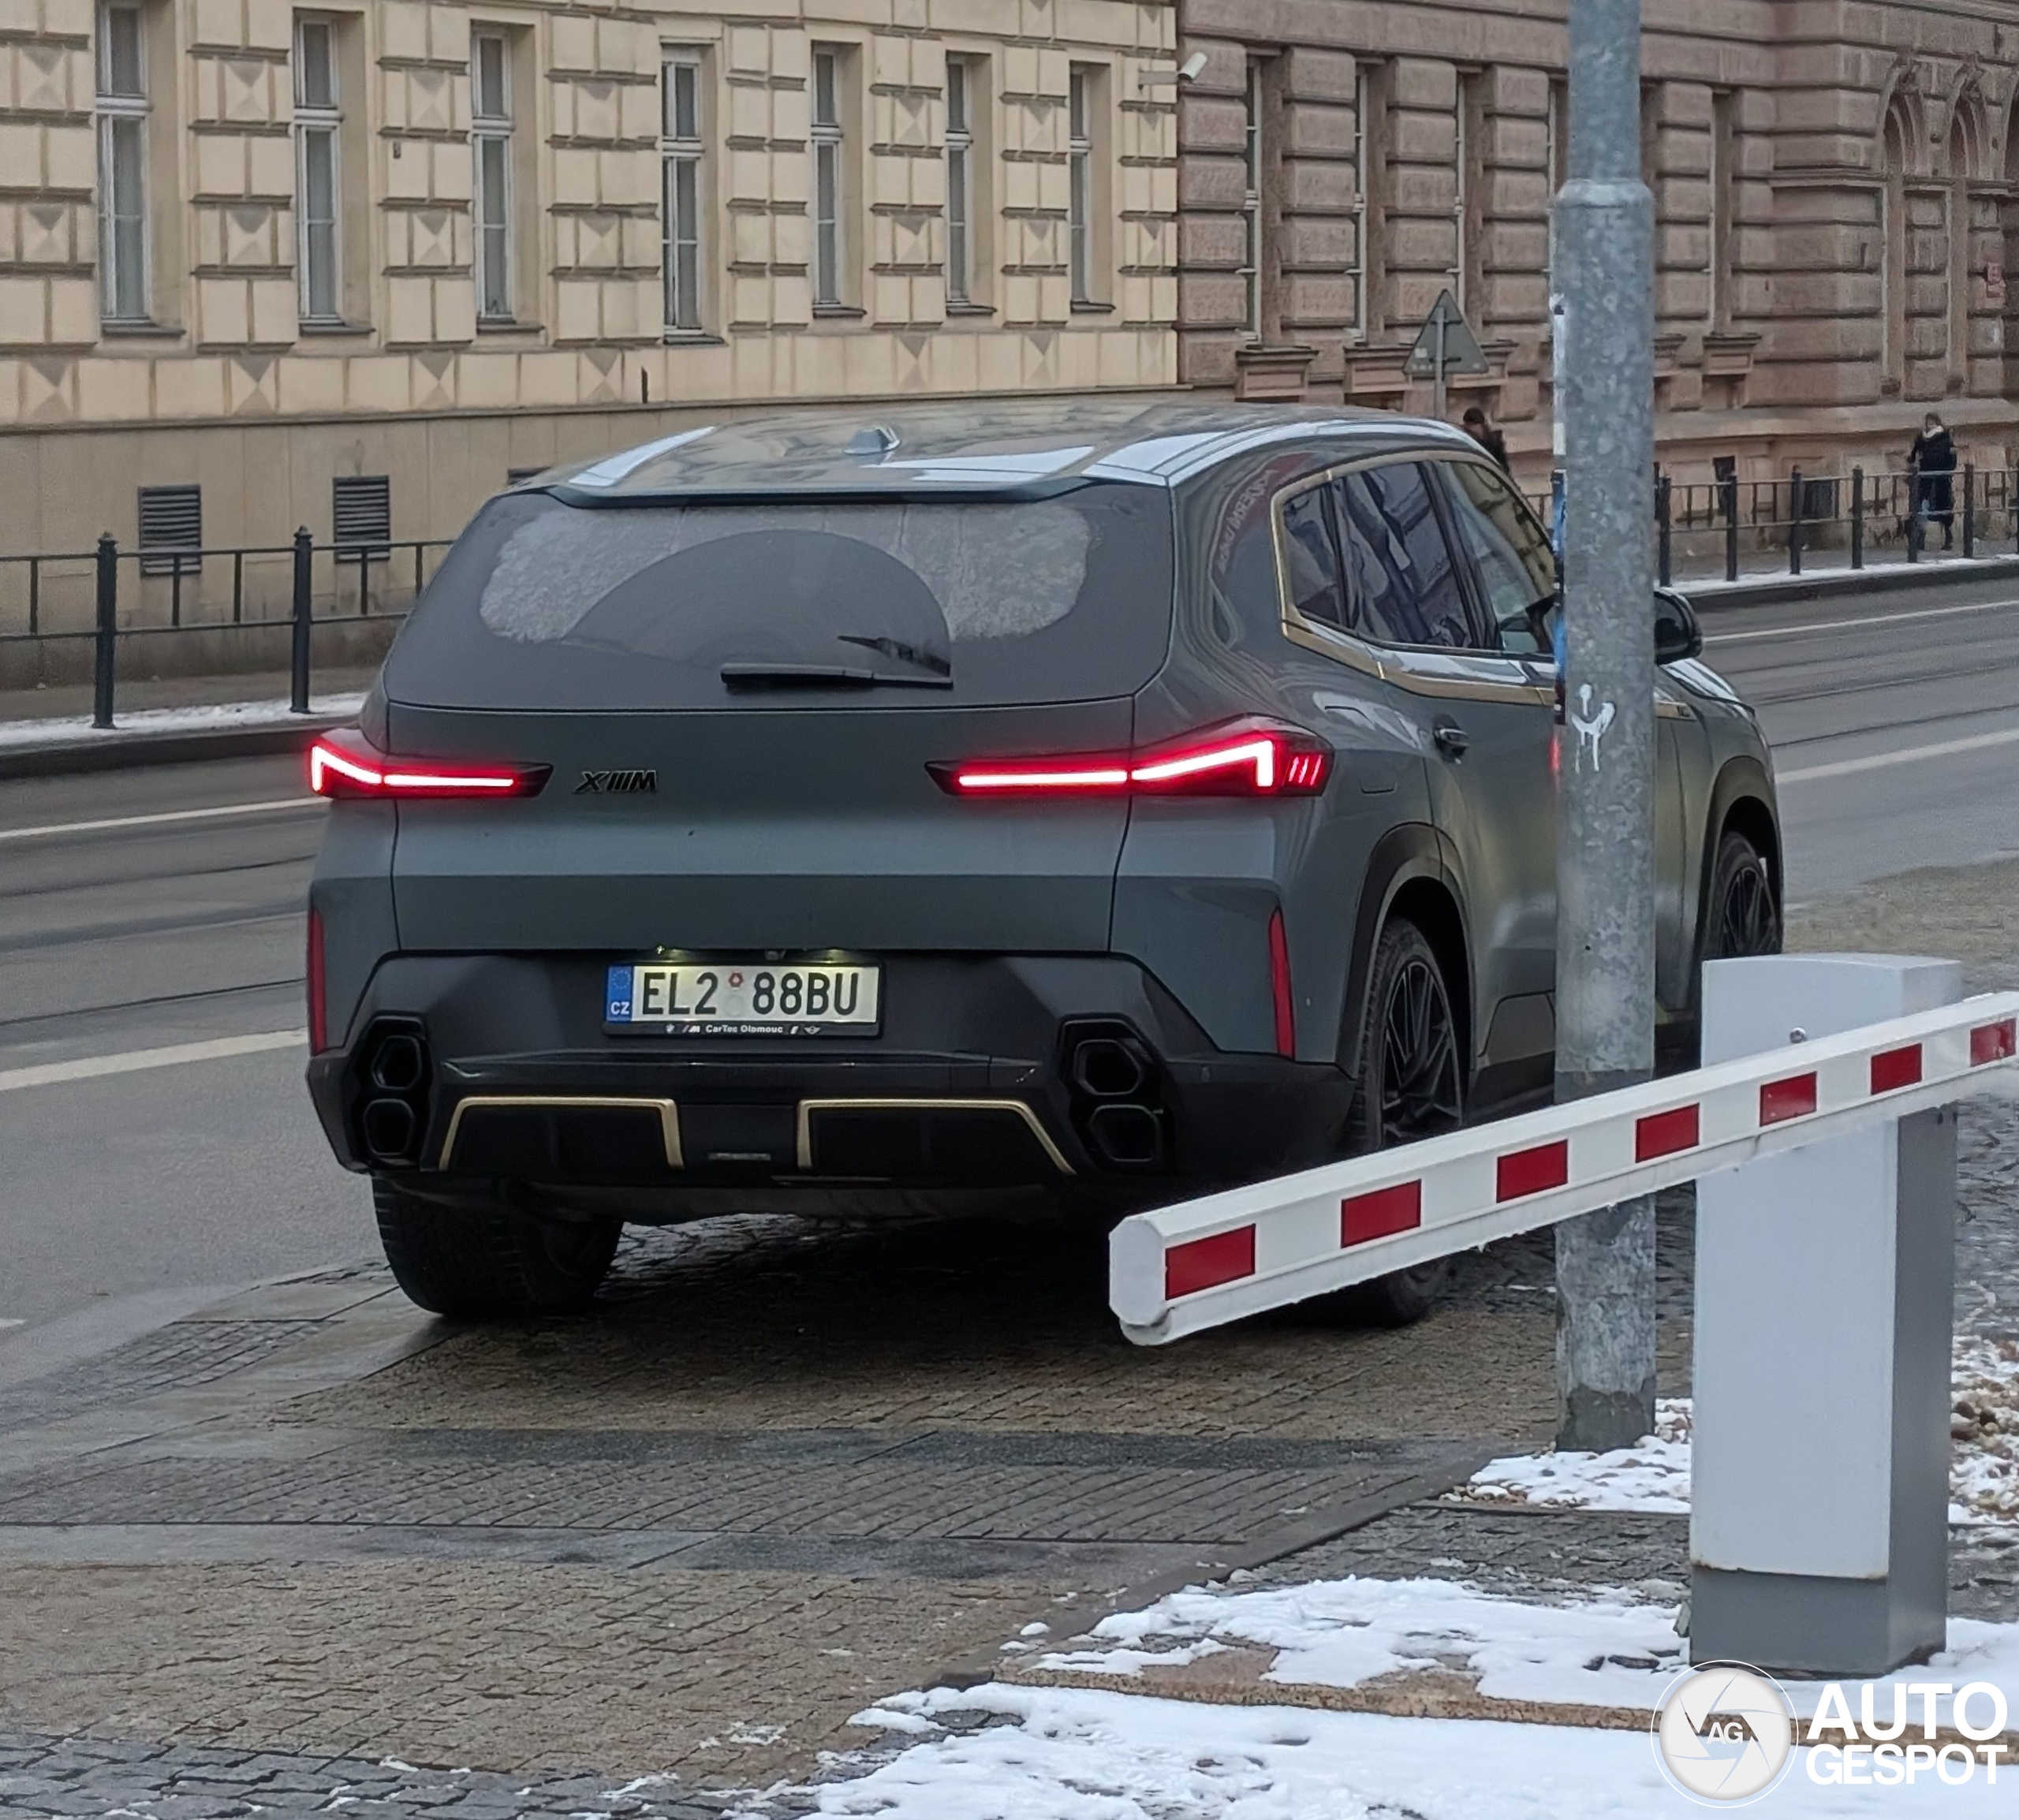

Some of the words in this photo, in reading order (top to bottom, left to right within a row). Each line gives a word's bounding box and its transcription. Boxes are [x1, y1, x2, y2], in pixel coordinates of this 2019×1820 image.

[642, 972, 718, 1015] EL2
[752, 972, 859, 1015] 88BU
[610, 1001, 630, 1015] CZ
[705, 1024, 738, 1033] CarTec
[740, 1024, 783, 1033] Olomouc
